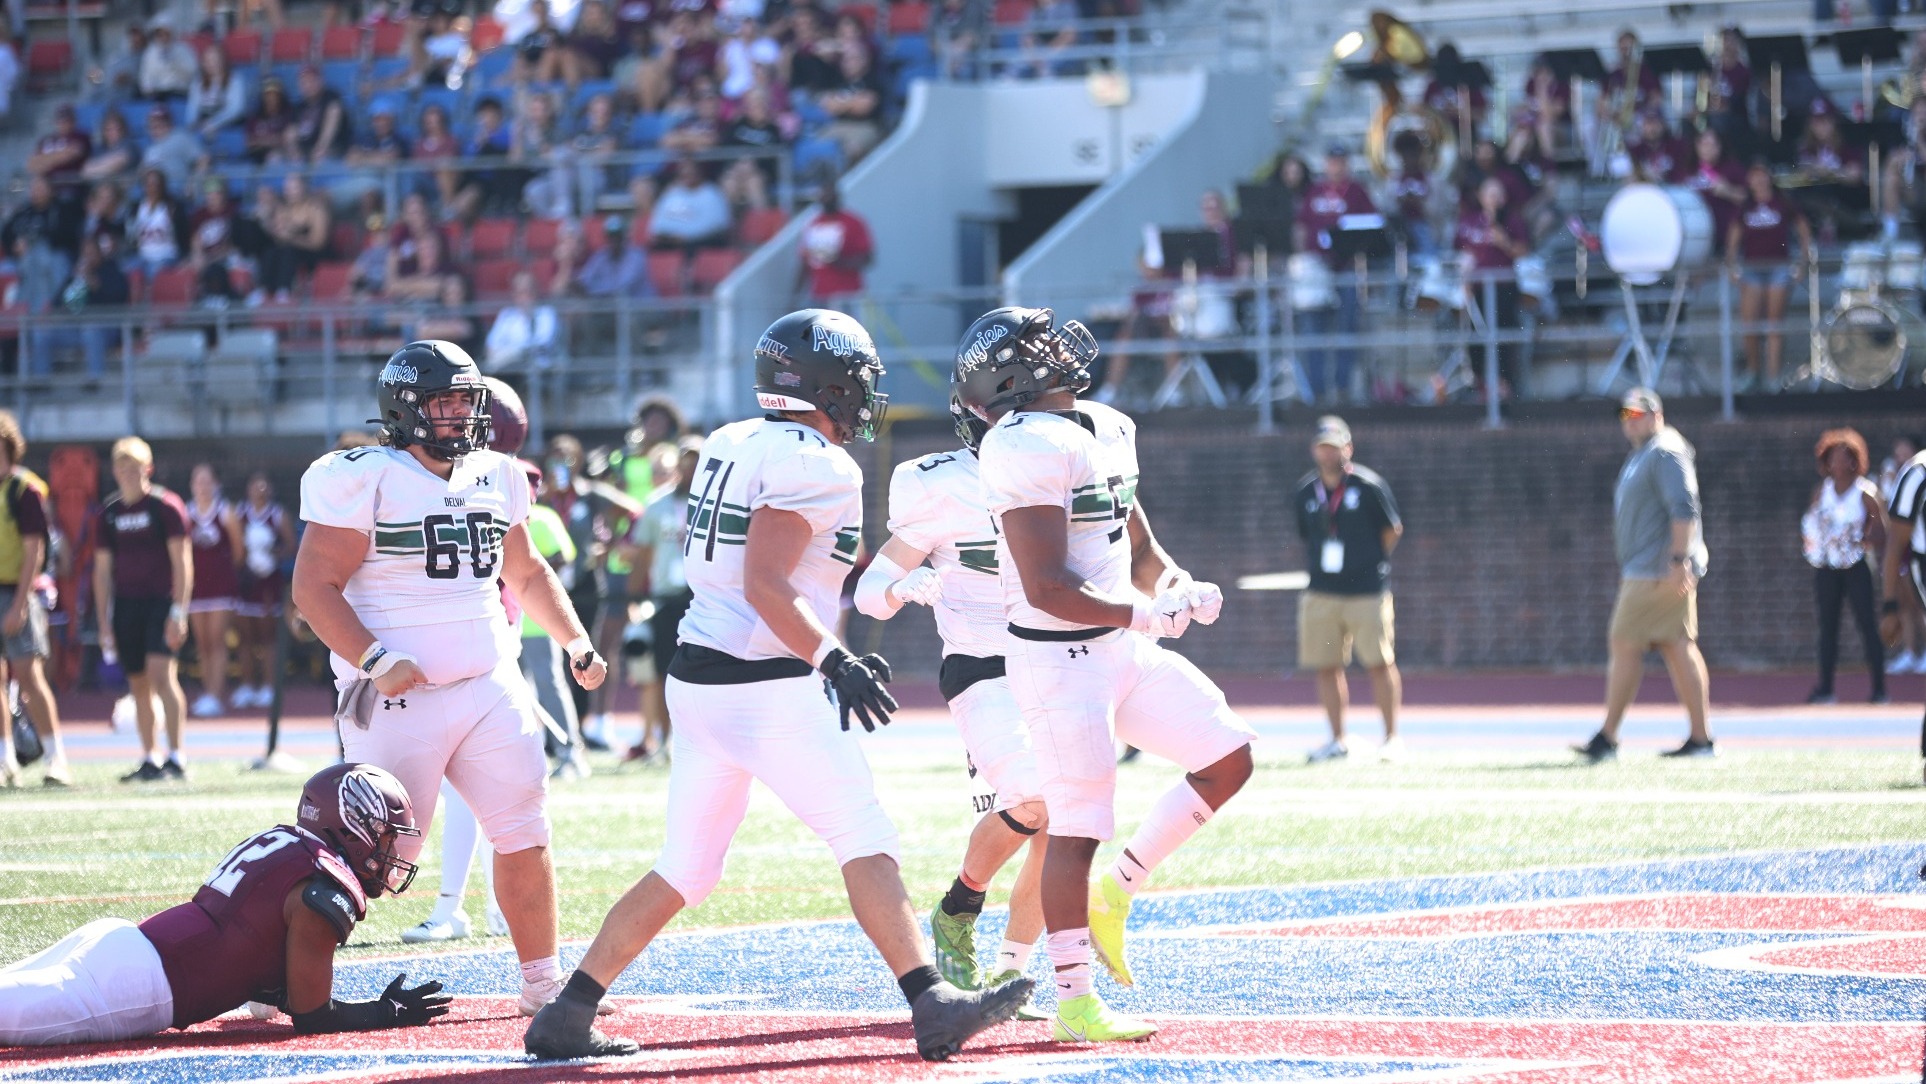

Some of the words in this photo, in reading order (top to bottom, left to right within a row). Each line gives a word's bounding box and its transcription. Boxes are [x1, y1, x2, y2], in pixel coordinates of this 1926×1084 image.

[379, 360, 418, 387] ggies
[958, 325, 1008, 383] Aggies
[761, 397, 787, 408] ddell
[684, 457, 735, 563] 71
[423, 512, 498, 579] 60
